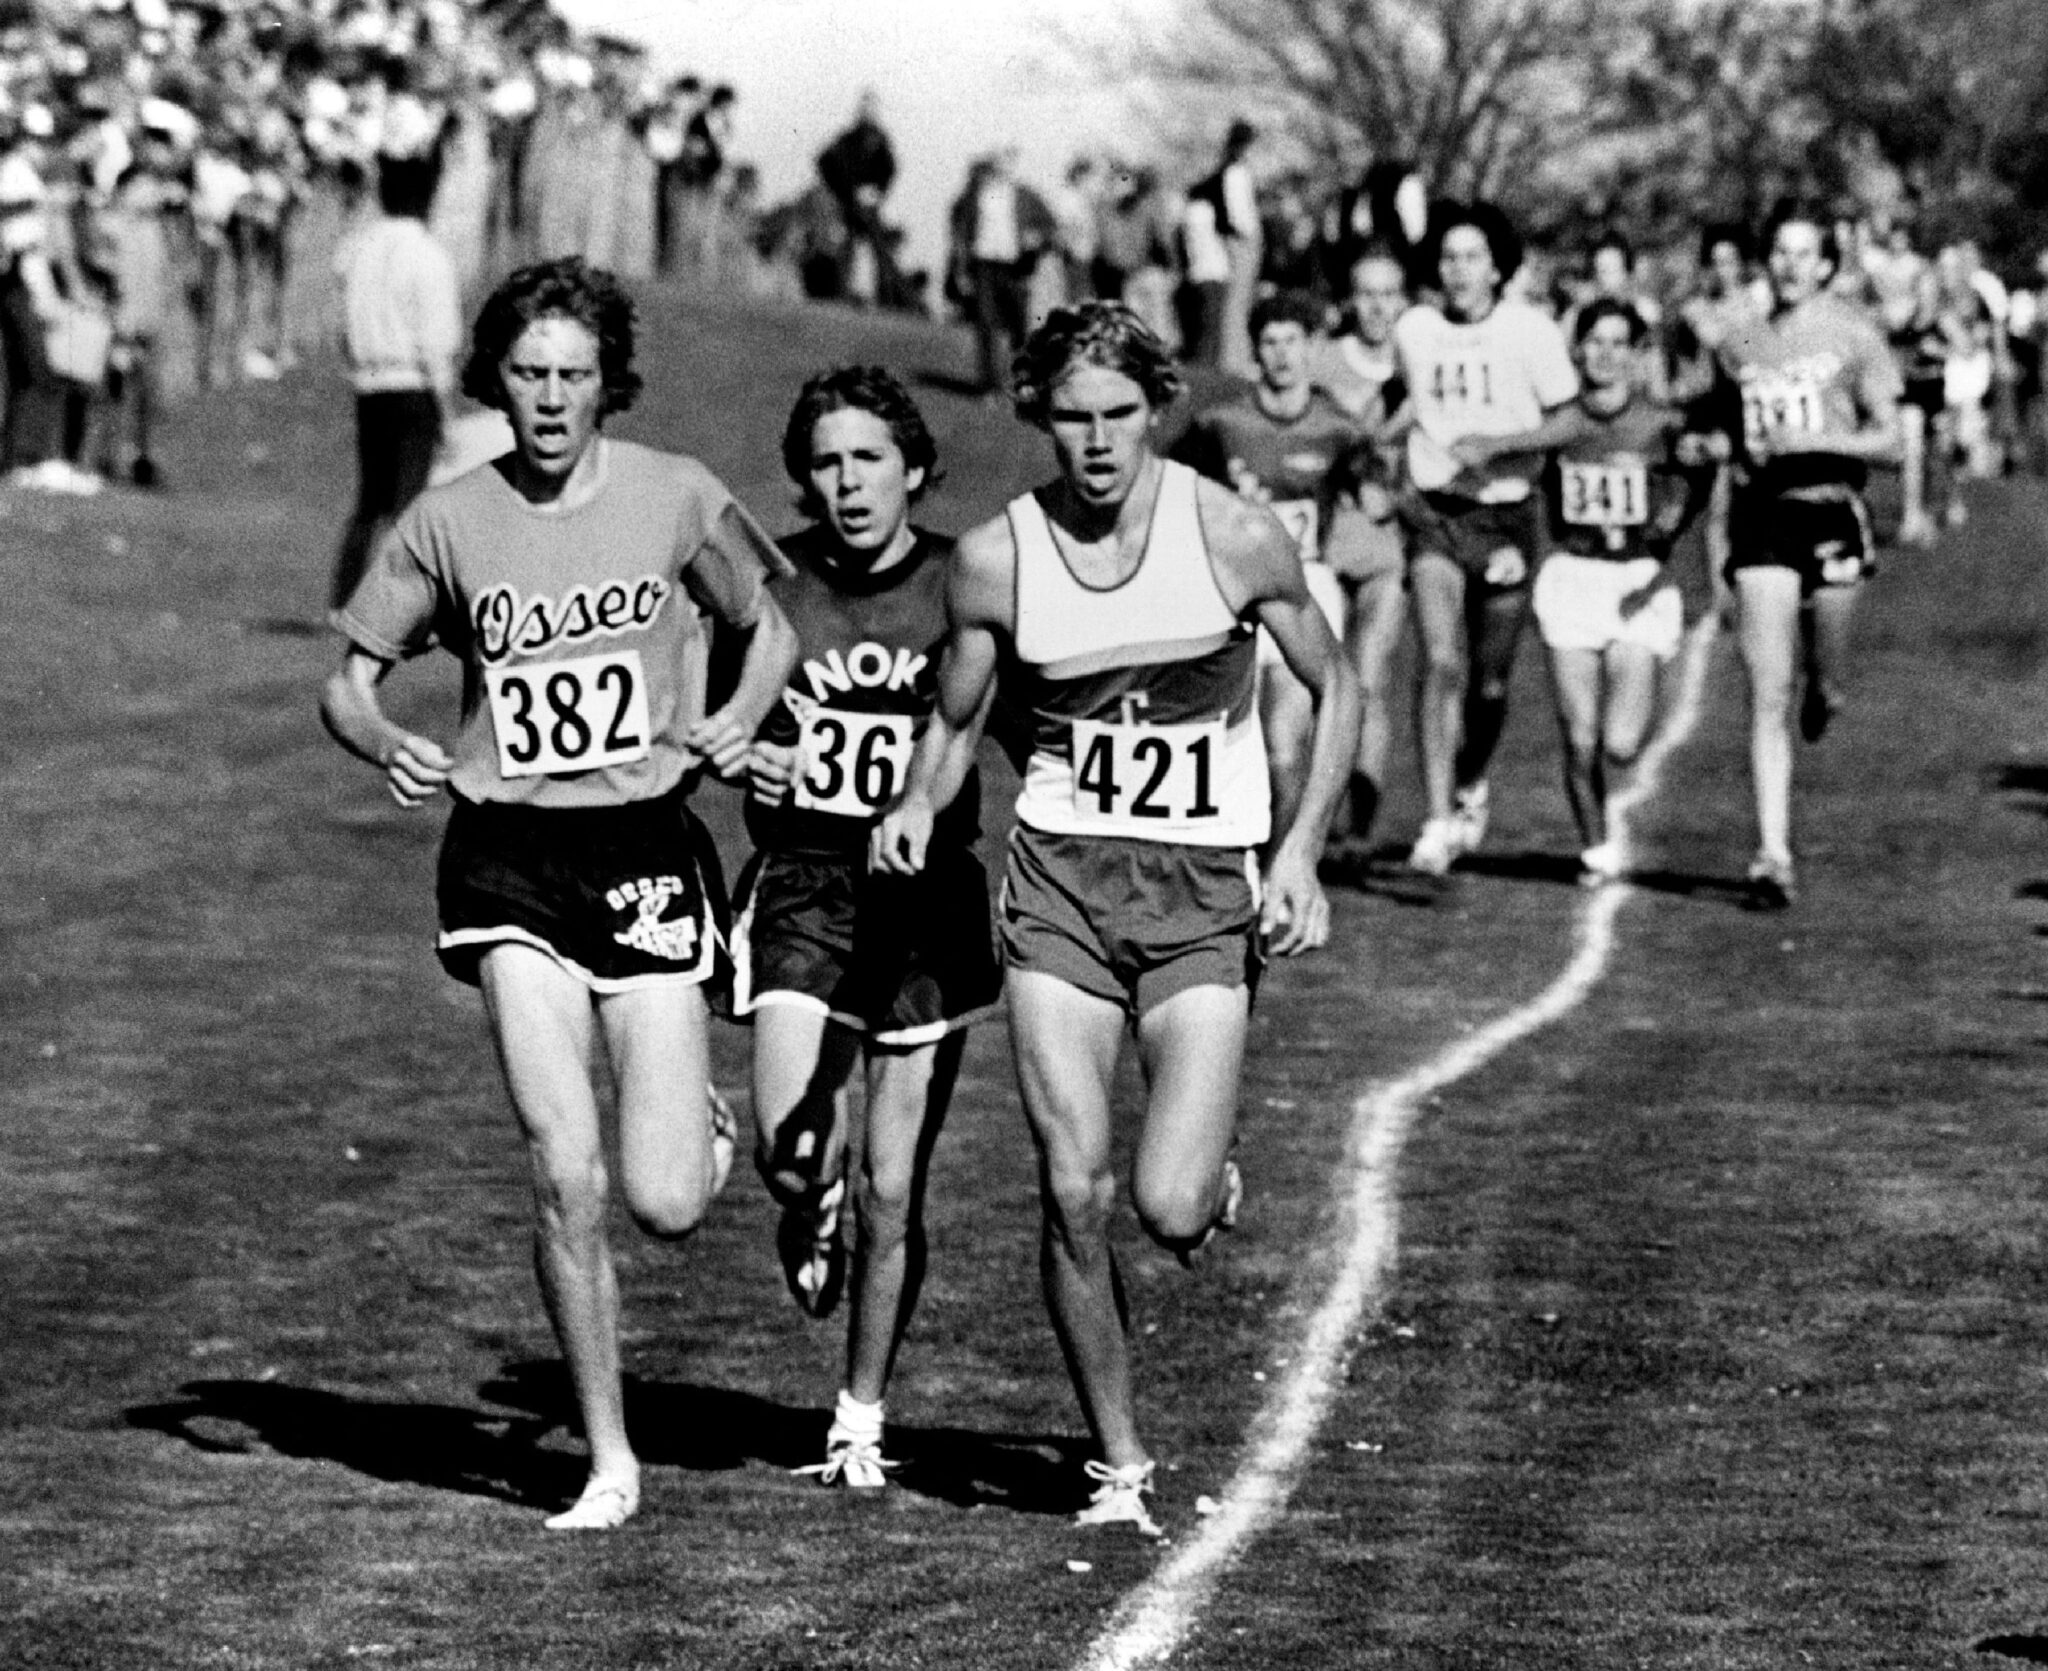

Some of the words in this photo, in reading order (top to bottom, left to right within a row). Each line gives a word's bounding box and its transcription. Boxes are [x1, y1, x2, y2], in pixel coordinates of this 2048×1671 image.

[473, 575, 669, 665] Osseo
[500, 664, 640, 763] 382
[804, 718, 897, 807] 36
[1079, 734, 1219, 818] 421
